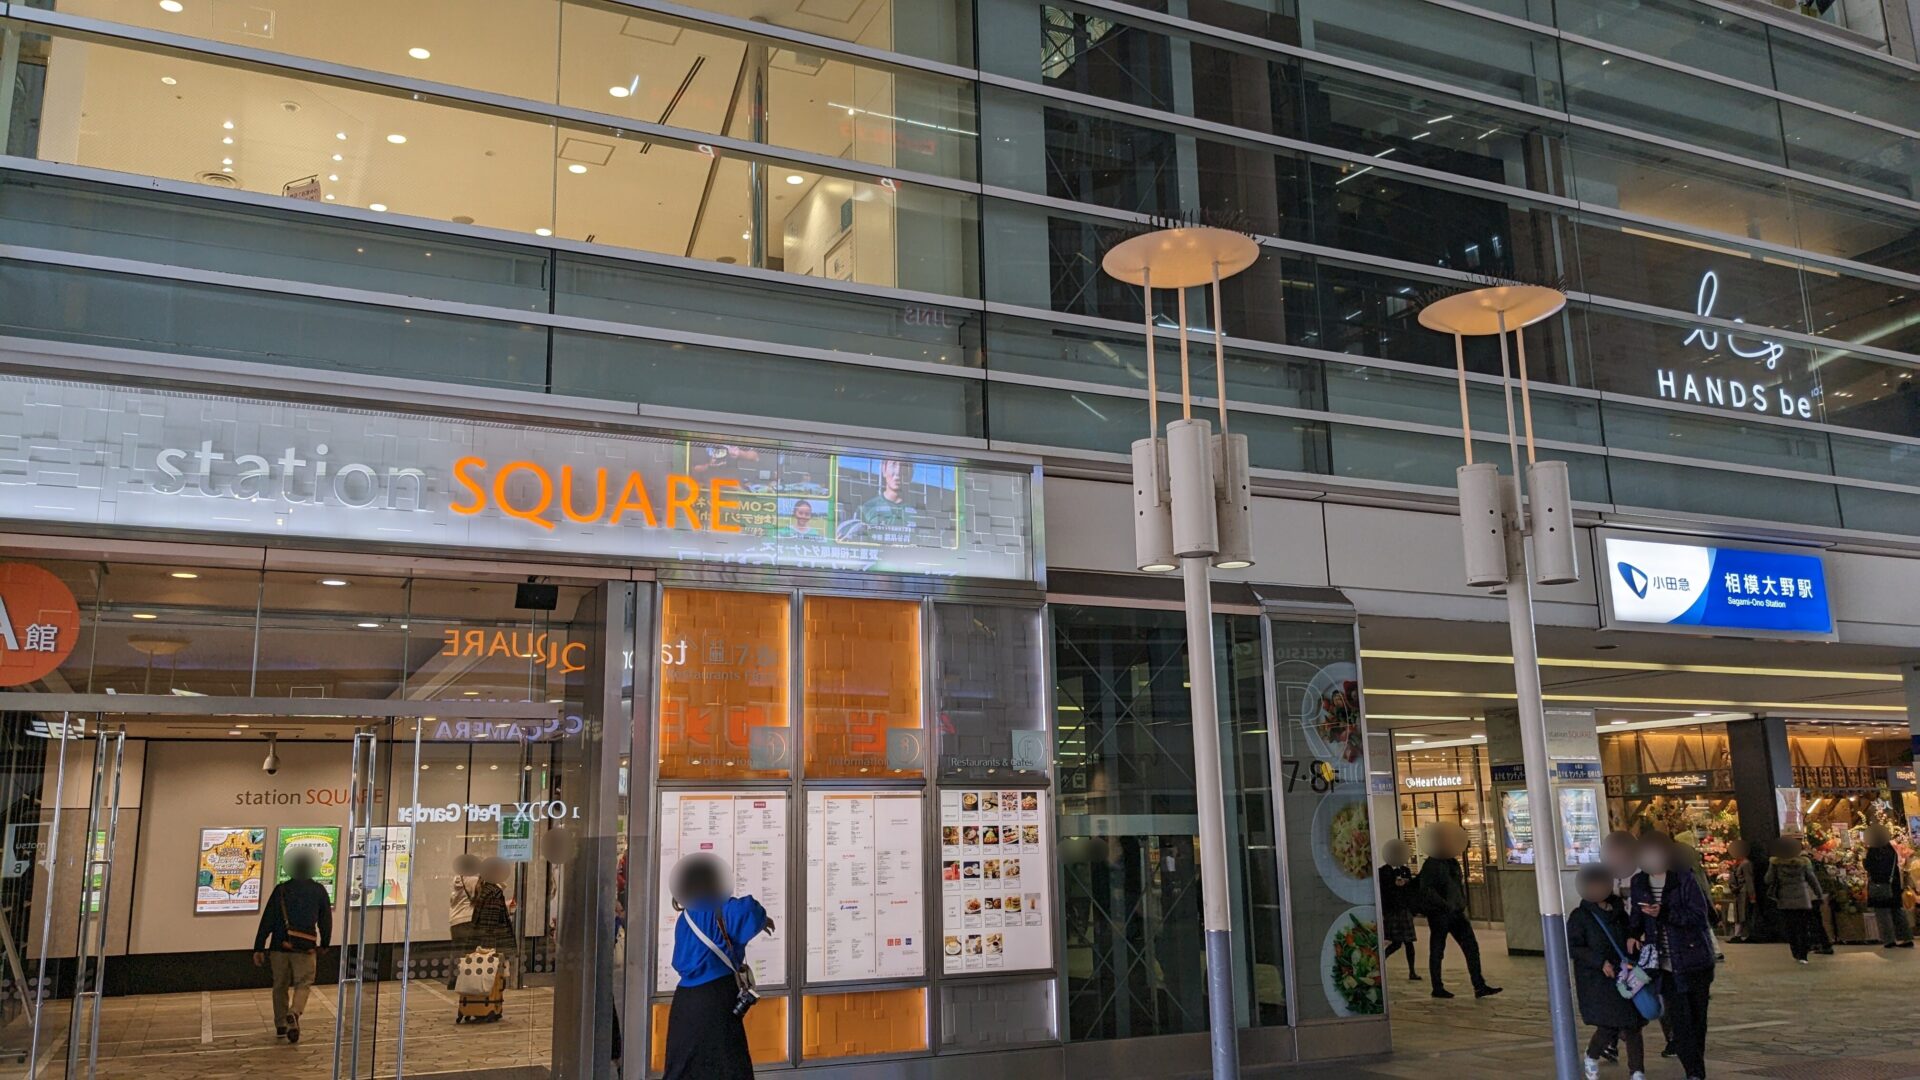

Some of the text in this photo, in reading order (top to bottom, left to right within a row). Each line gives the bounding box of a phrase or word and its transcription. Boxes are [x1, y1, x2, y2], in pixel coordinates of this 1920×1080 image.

[1657, 369, 1812, 419] HANDS be
[151, 440, 743, 533] station SQUARE
[1653, 575, 1691, 592] 小田急
[1725, 572, 1814, 599] 相模大野駅
[1727, 597, 1786, 609] Sagami-Ono Station
[950, 757, 1001, 767] Restaurants
[1415, 774, 1462, 788] Heartdance
[235, 788, 301, 805] station
